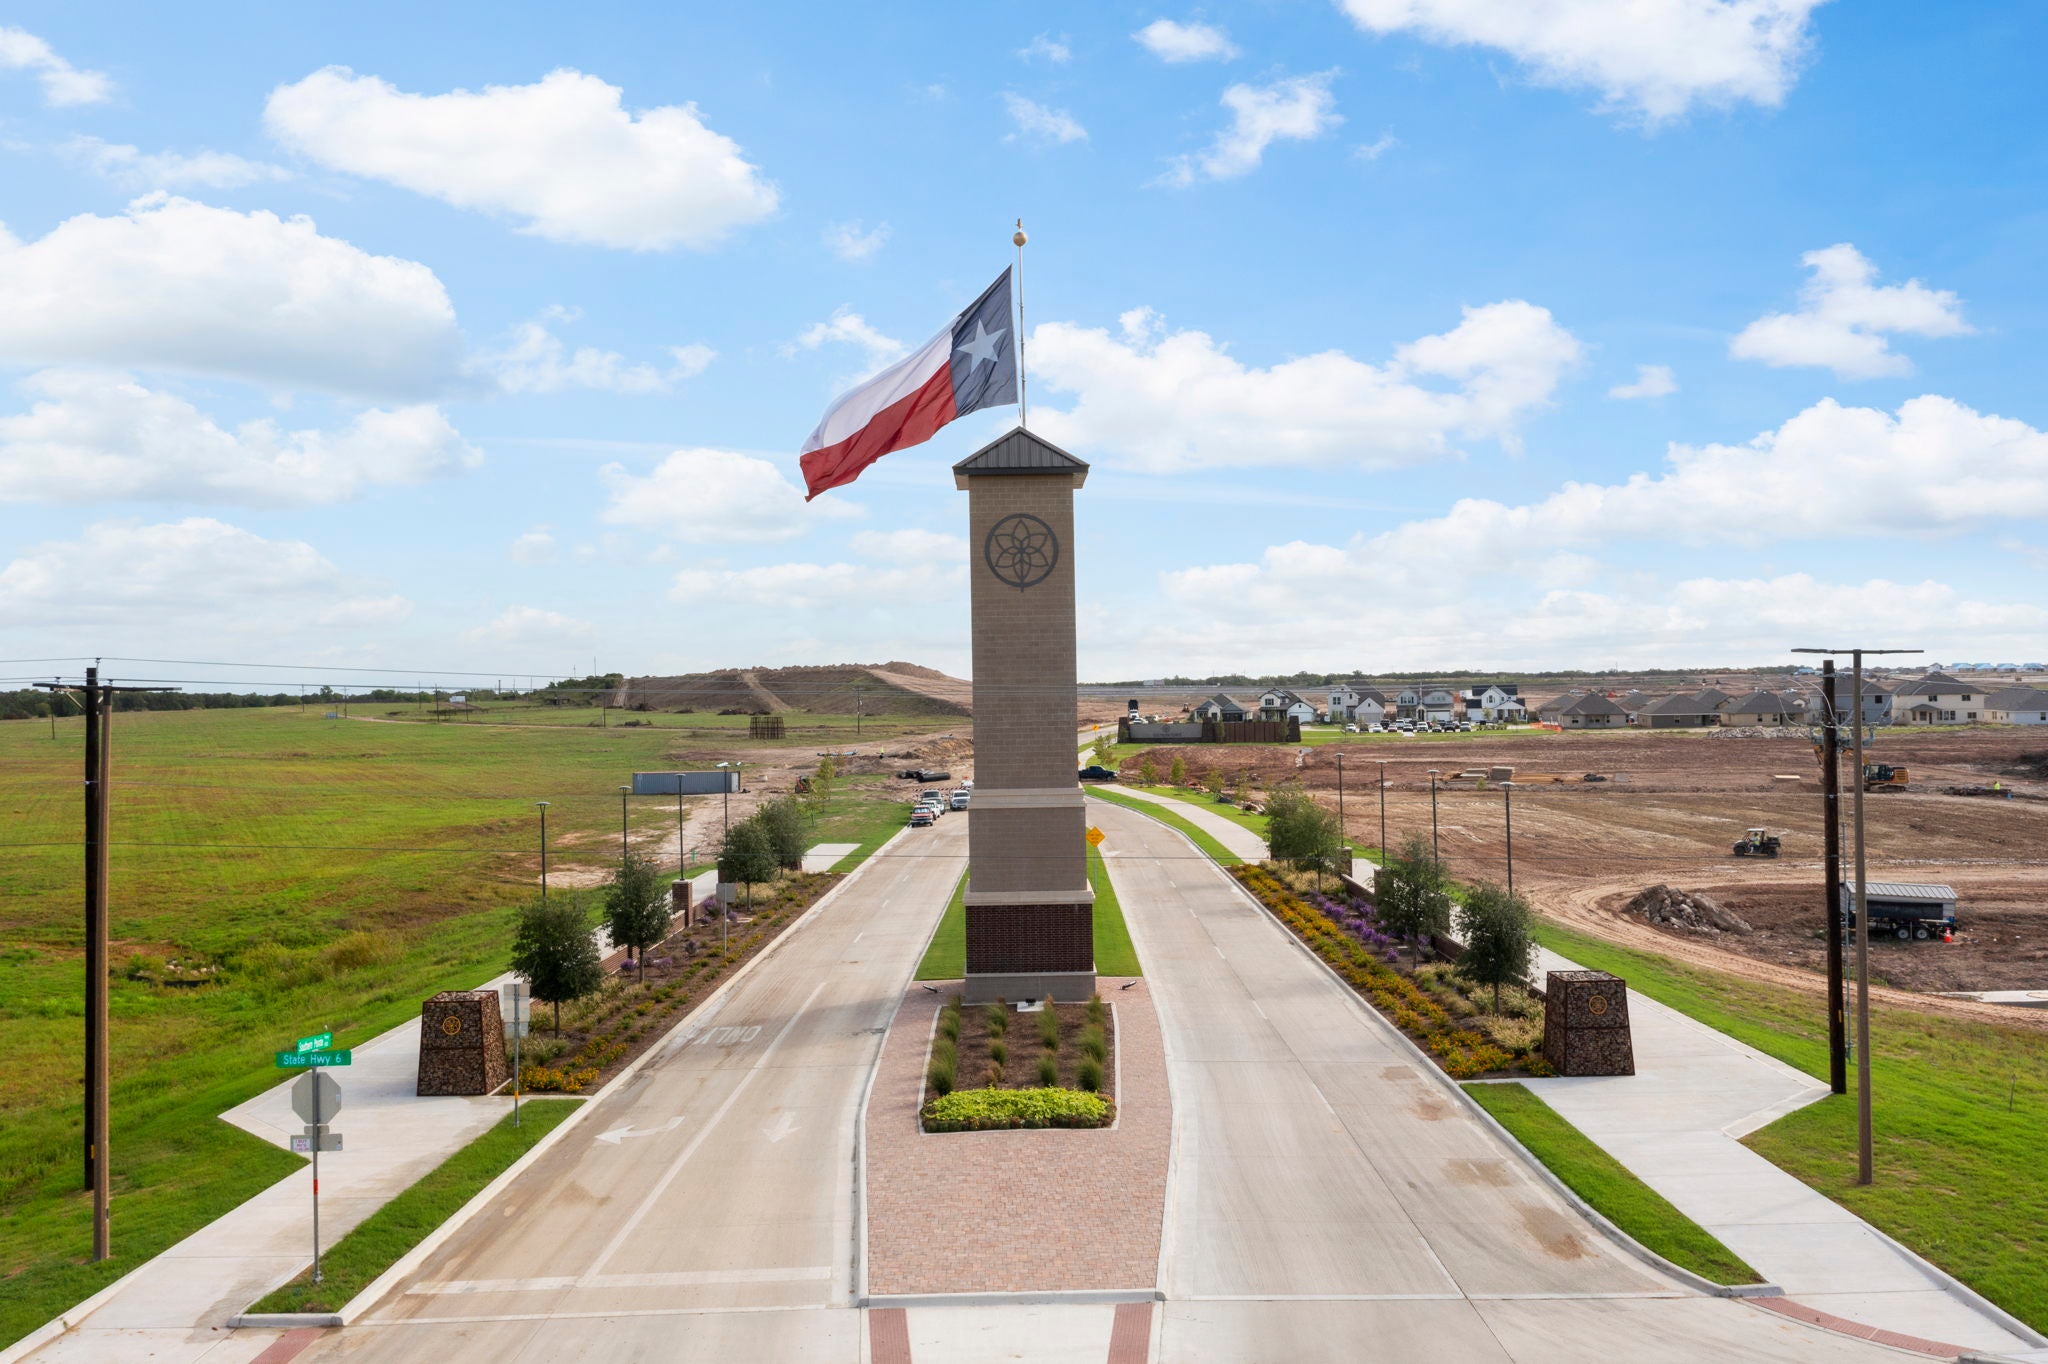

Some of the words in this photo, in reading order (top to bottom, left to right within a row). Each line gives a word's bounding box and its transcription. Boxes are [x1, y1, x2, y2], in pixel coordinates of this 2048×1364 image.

[692, 1025, 762, 1044] ONLY
[283, 1054, 306, 1065] State
[310, 1053, 331, 1066] Hwy
[335, 1053, 342, 1063] 6
